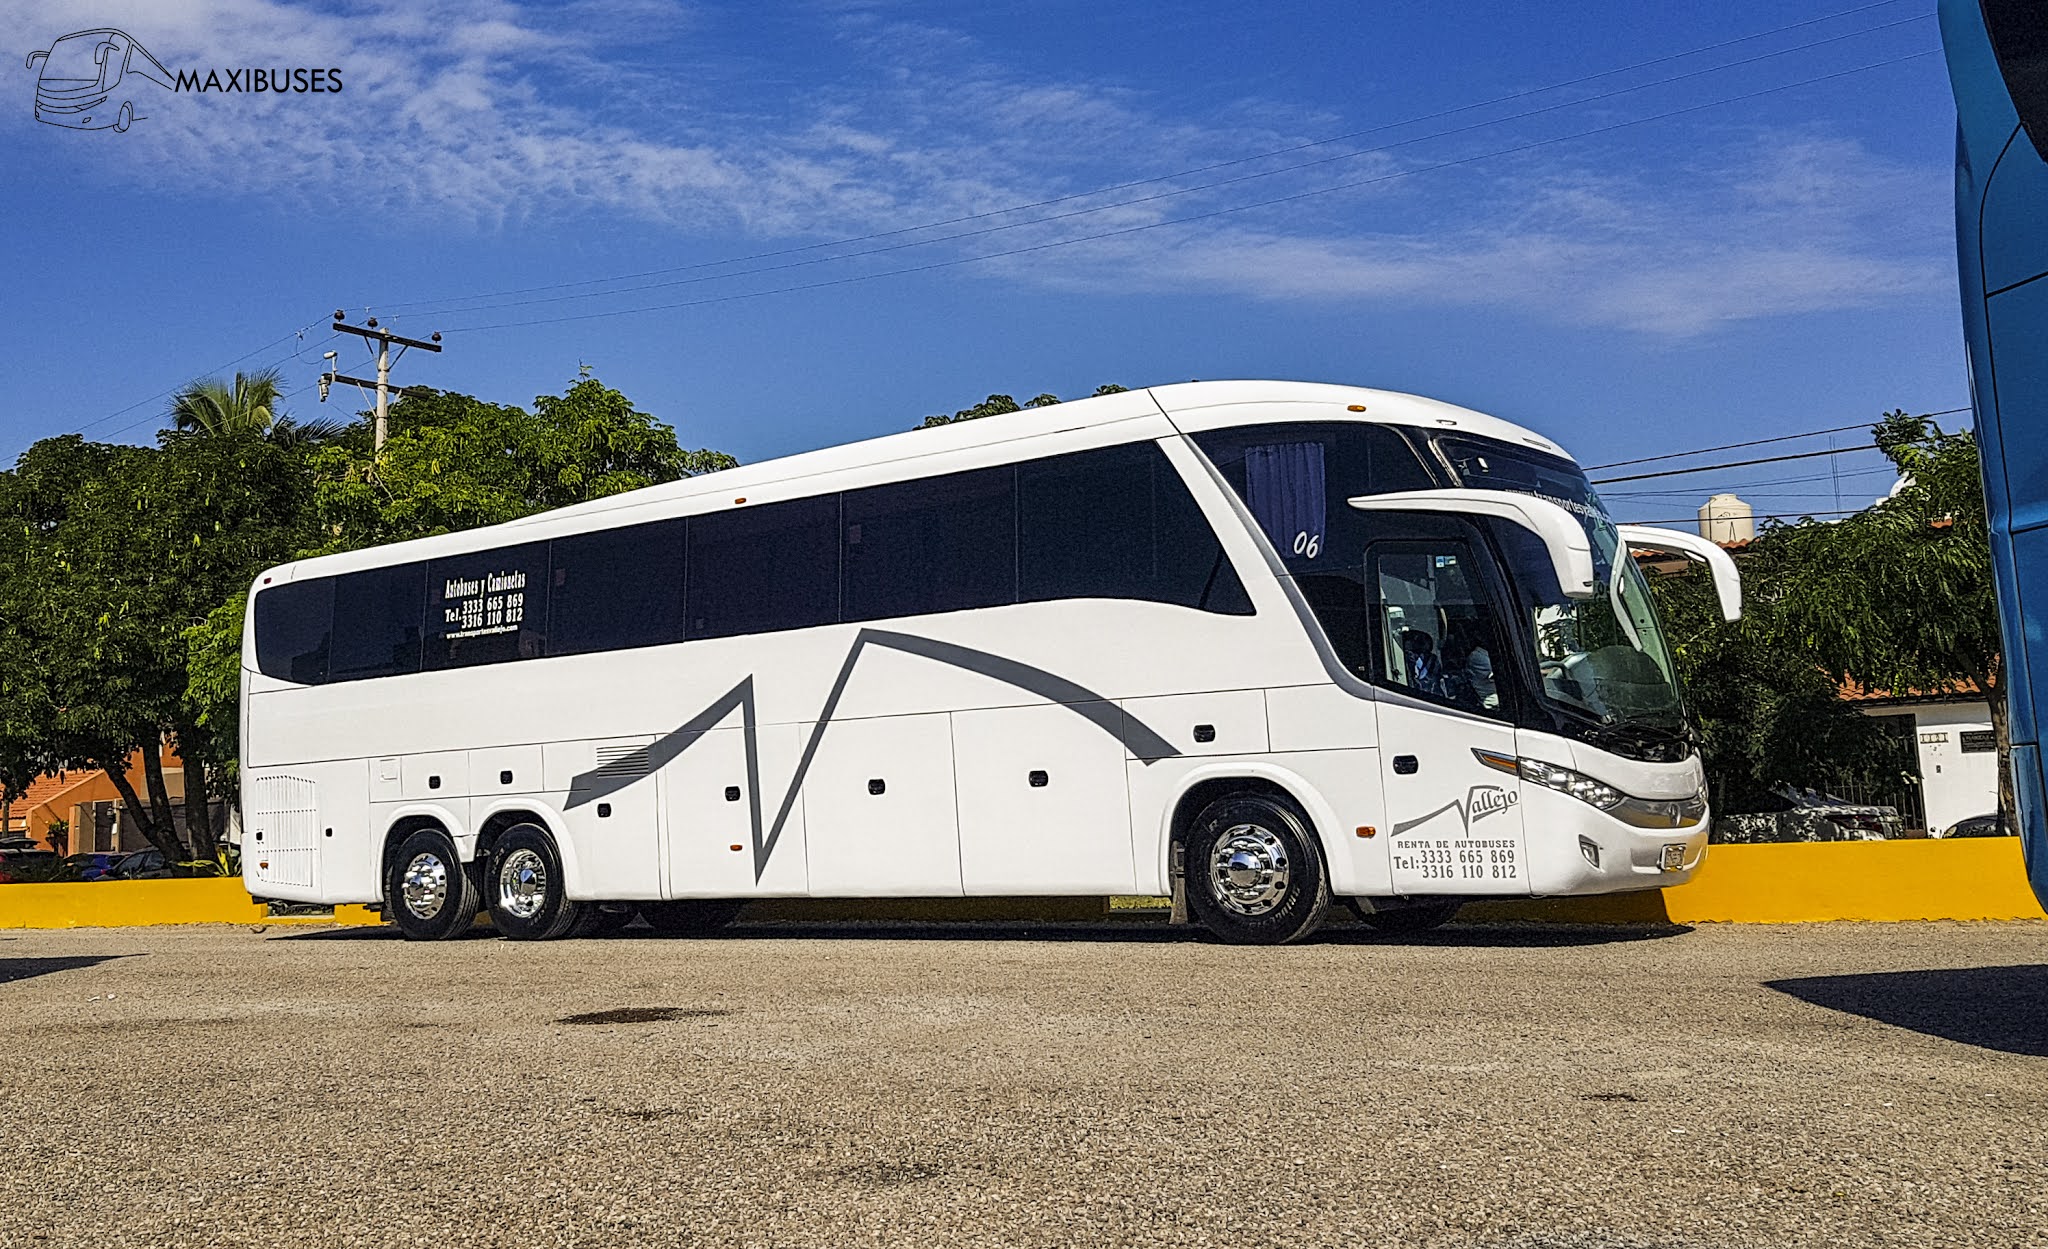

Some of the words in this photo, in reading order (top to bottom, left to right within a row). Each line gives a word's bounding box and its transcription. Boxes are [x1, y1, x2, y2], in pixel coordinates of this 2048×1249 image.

[1293, 531, 1320, 559] 06
[445, 577, 479, 599] Autobuses
[487, 569, 526, 593] Camionetas
[462, 599, 483, 615] 3333
[486, 595, 504, 612] 665
[506, 592, 524, 609] 869
[445, 608, 462, 622] Tel.
[461, 613, 483, 629] 3316
[486, 610, 503, 626] 110
[505, 608, 523, 623] 812
[1397, 840, 1431, 849] RENTA
[1436, 840, 1449, 849] DE
[1454, 839, 1516, 849] AUTOBUSES
[1393, 855, 1421, 870] Tel:
[1420, 849, 1453, 864] 3333
[1459, 849, 1484, 864] 665
[1491, 849, 1515, 864] 869
[1422, 864, 1454, 879] 3316
[1462, 864, 1484, 879] 110
[1492, 864, 1517, 879] 812
